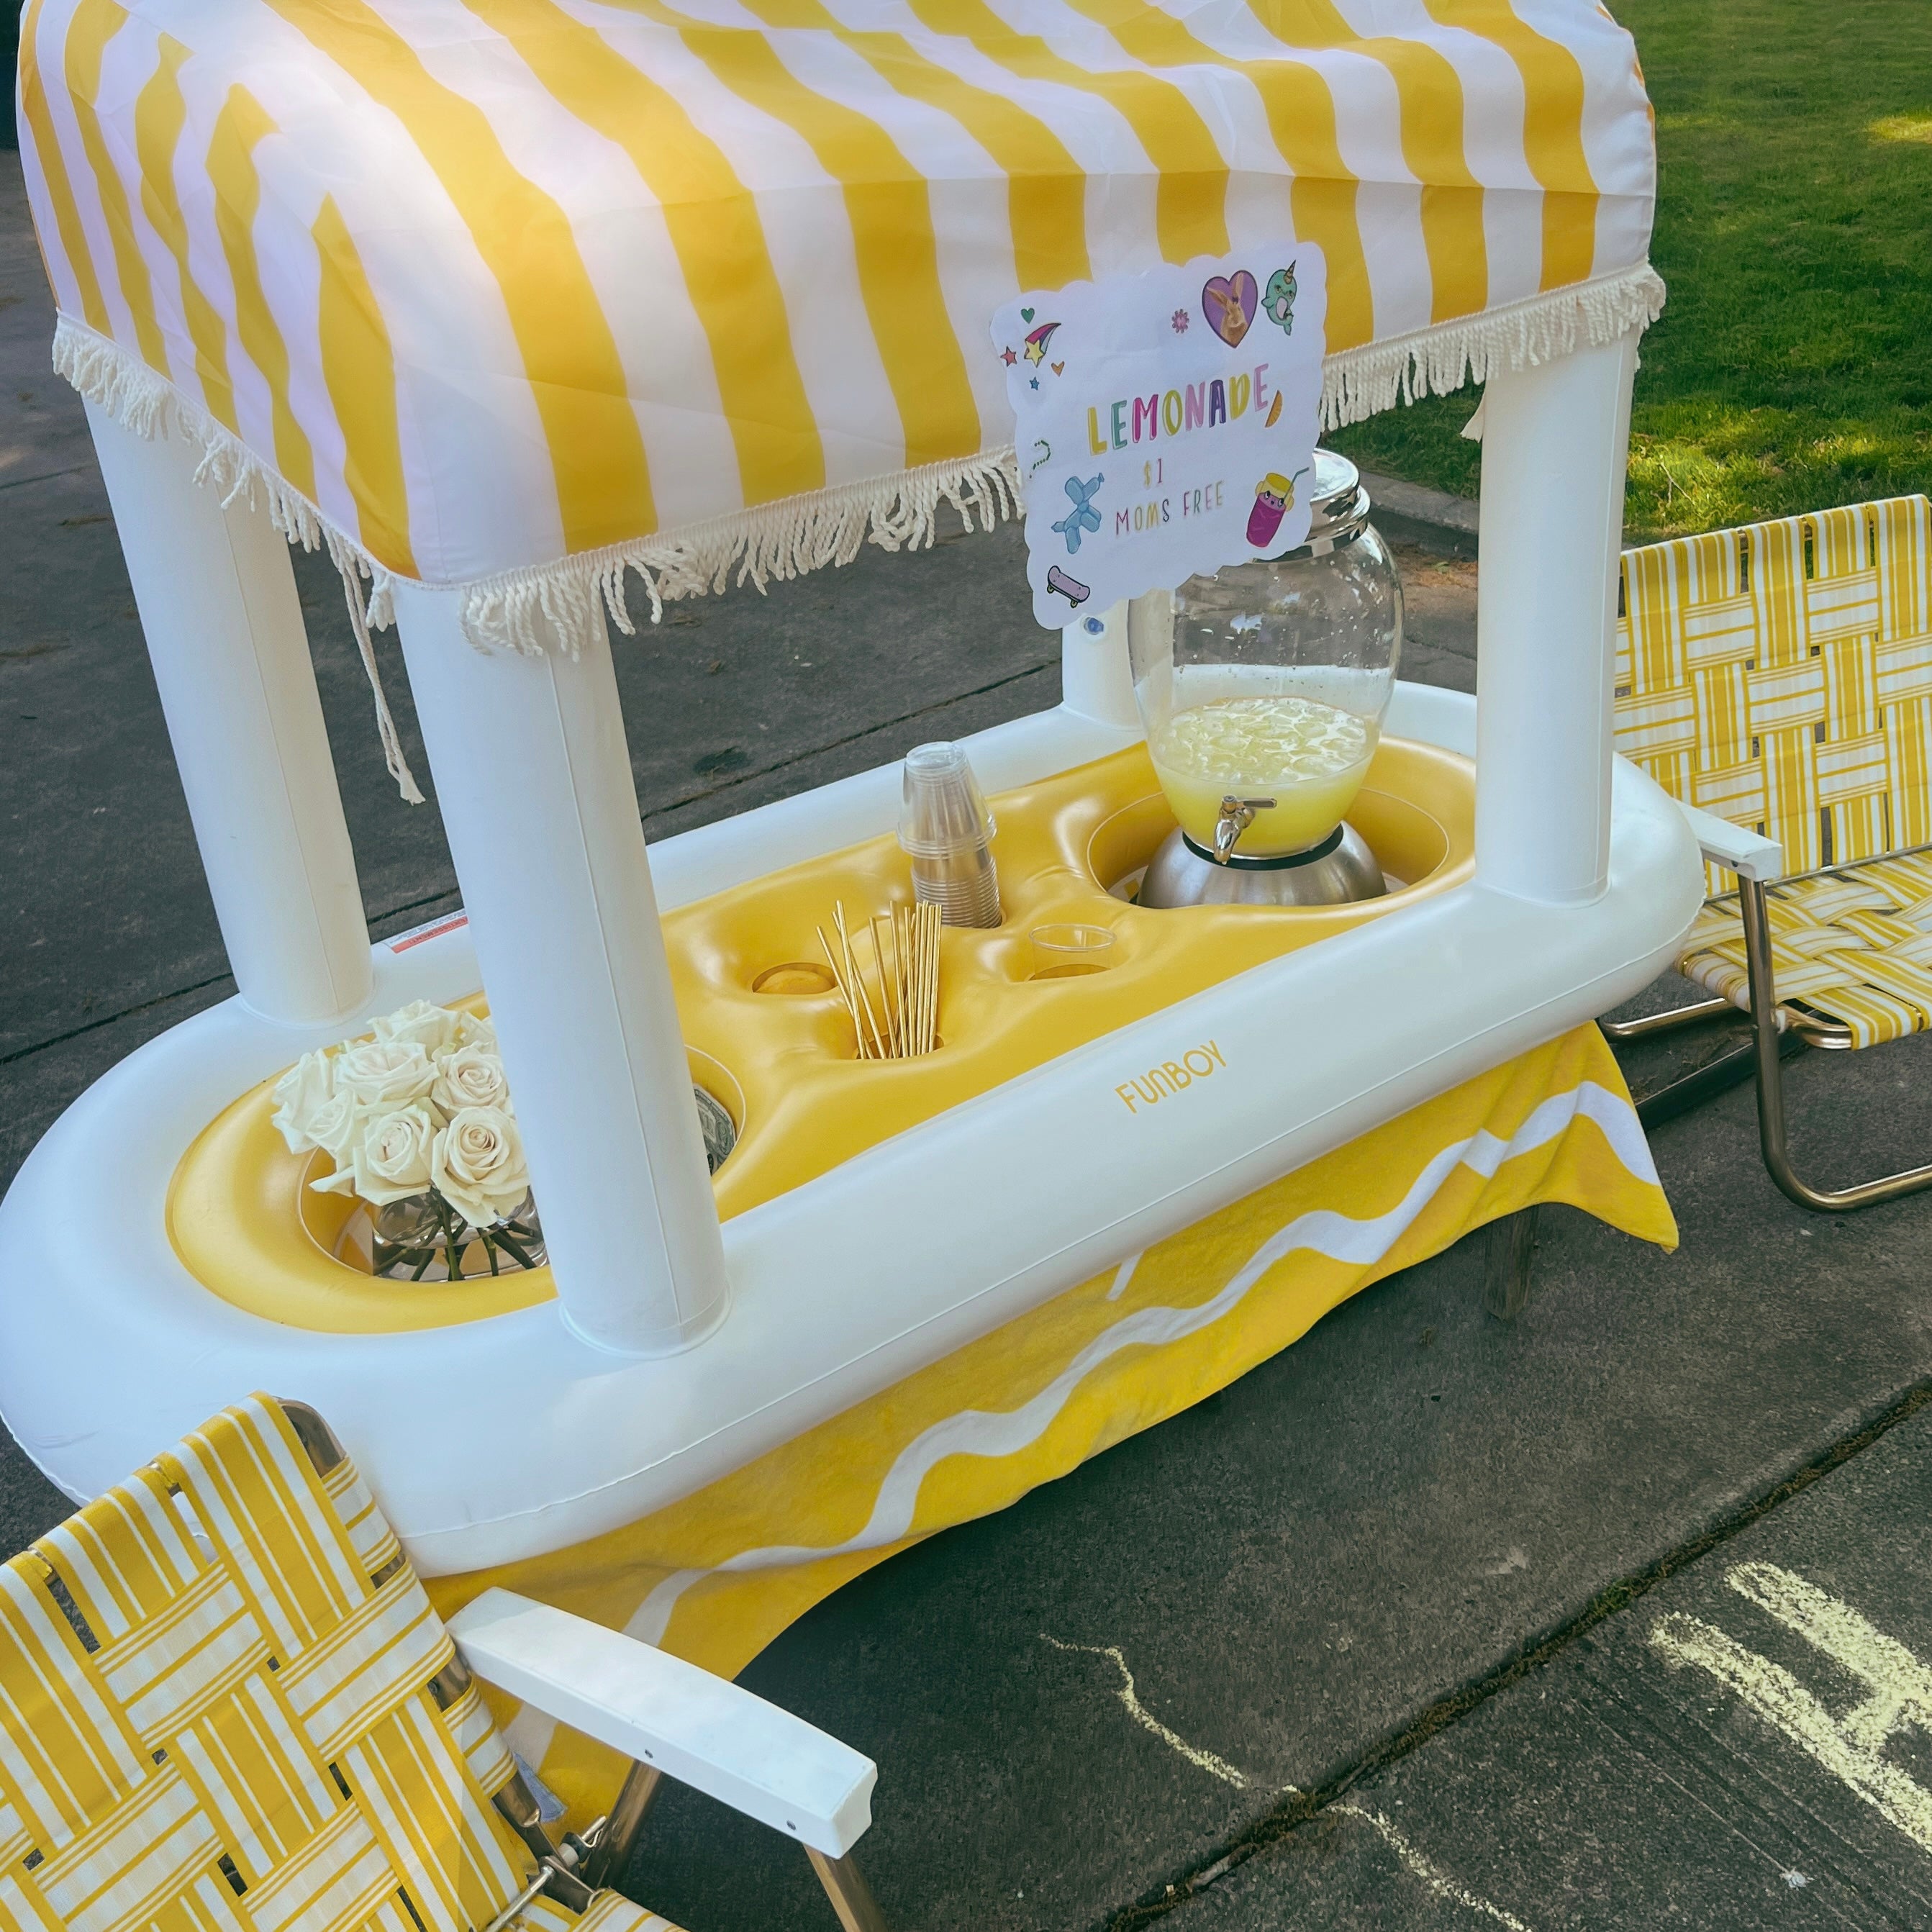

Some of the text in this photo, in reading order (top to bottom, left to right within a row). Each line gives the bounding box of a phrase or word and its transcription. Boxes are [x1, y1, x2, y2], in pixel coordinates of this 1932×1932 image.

[1087, 363, 1269, 456] LEMONADE
[1115, 480, 1224, 535] MOMS FREE
[1115, 1039, 1227, 1114] FUNBOY
